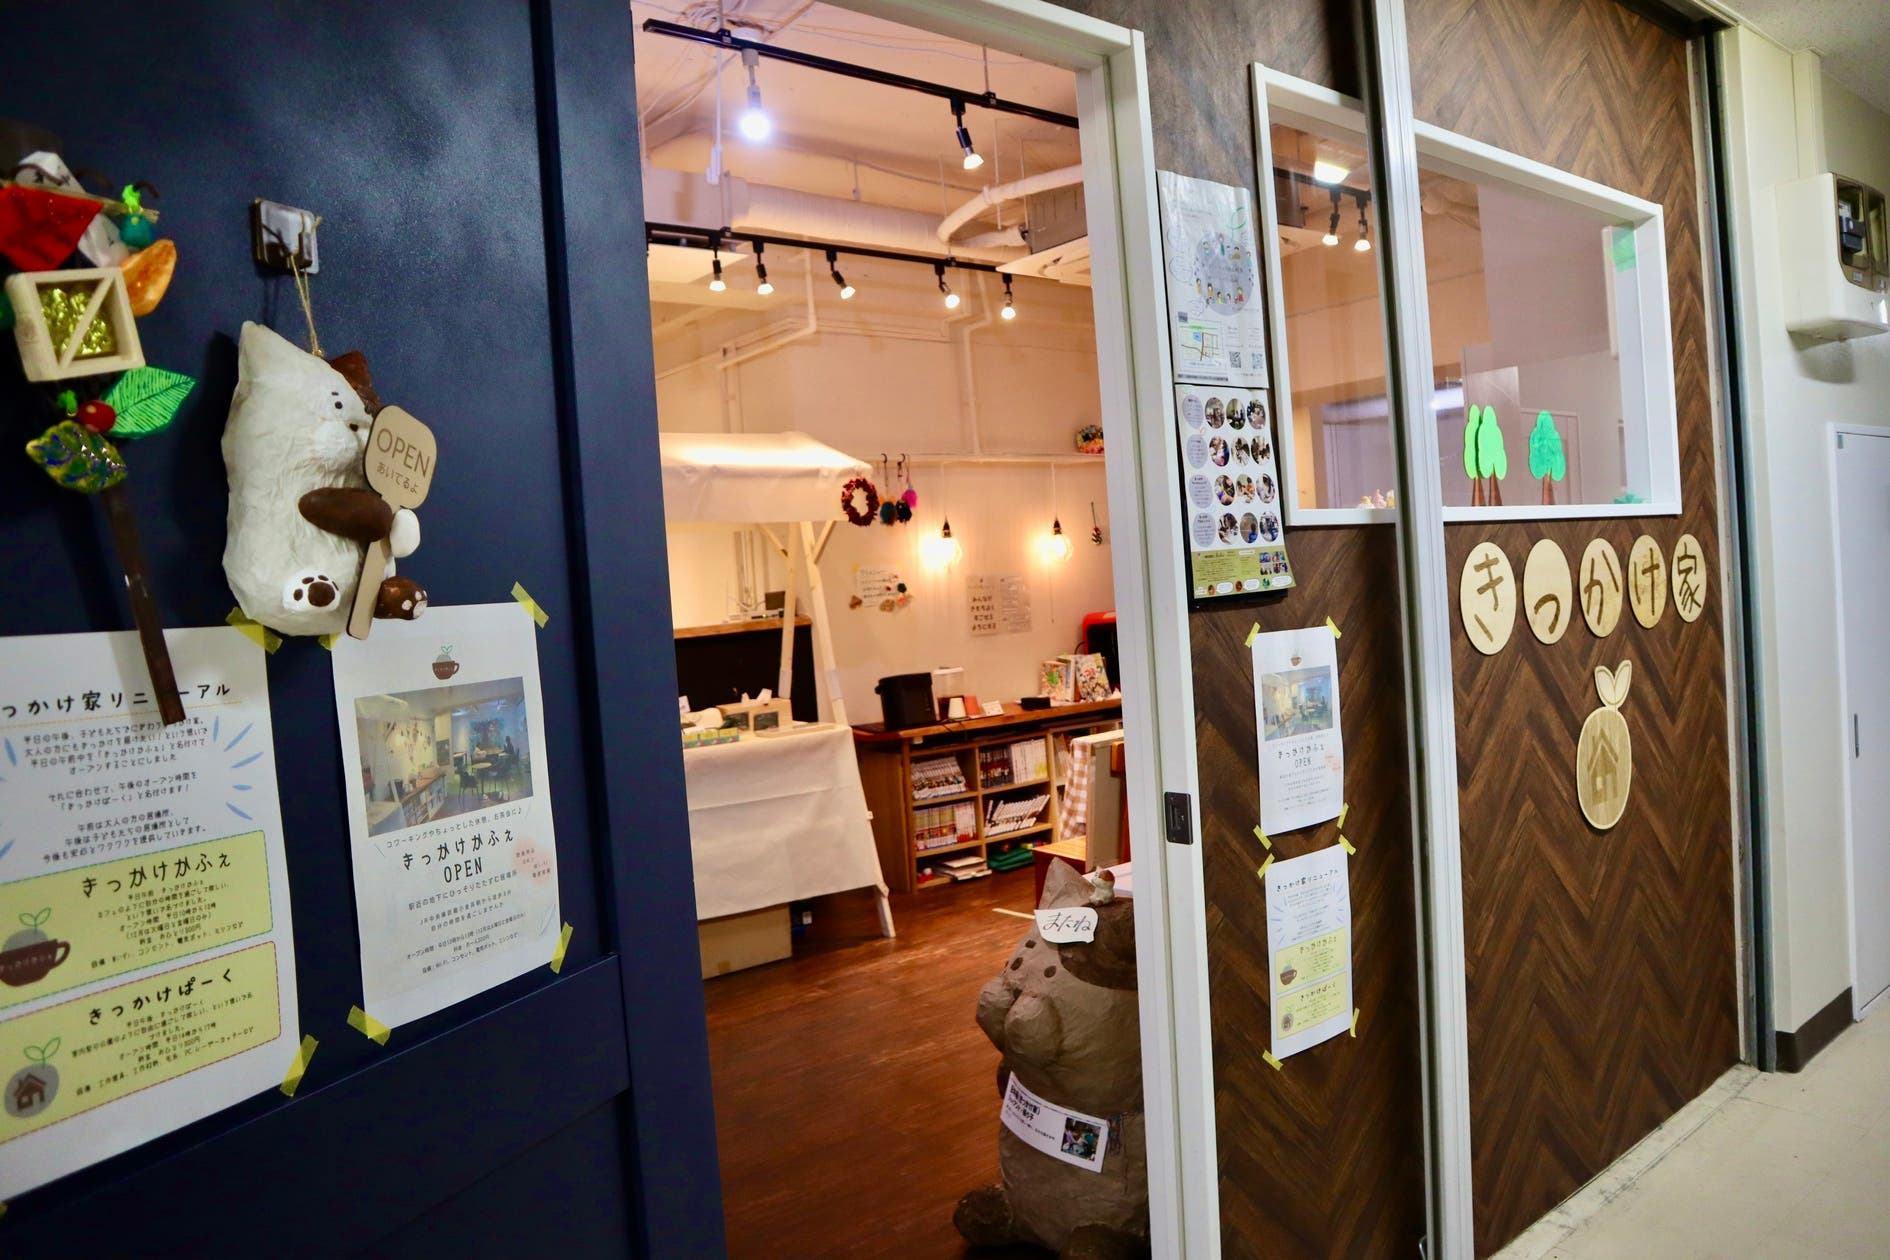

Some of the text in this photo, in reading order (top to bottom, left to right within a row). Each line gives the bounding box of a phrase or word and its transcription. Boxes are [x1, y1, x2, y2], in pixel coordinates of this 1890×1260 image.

[377, 428, 430, 478] OPEN
[2, 683, 230, 718] っかけ家リニーアル
[1295, 757, 1312, 768] OPEN
[444, 857, 483, 884] OPEN
[1043, 912, 1091, 932] またね
[88, 968, 233, 1026] きっかけぱーく
